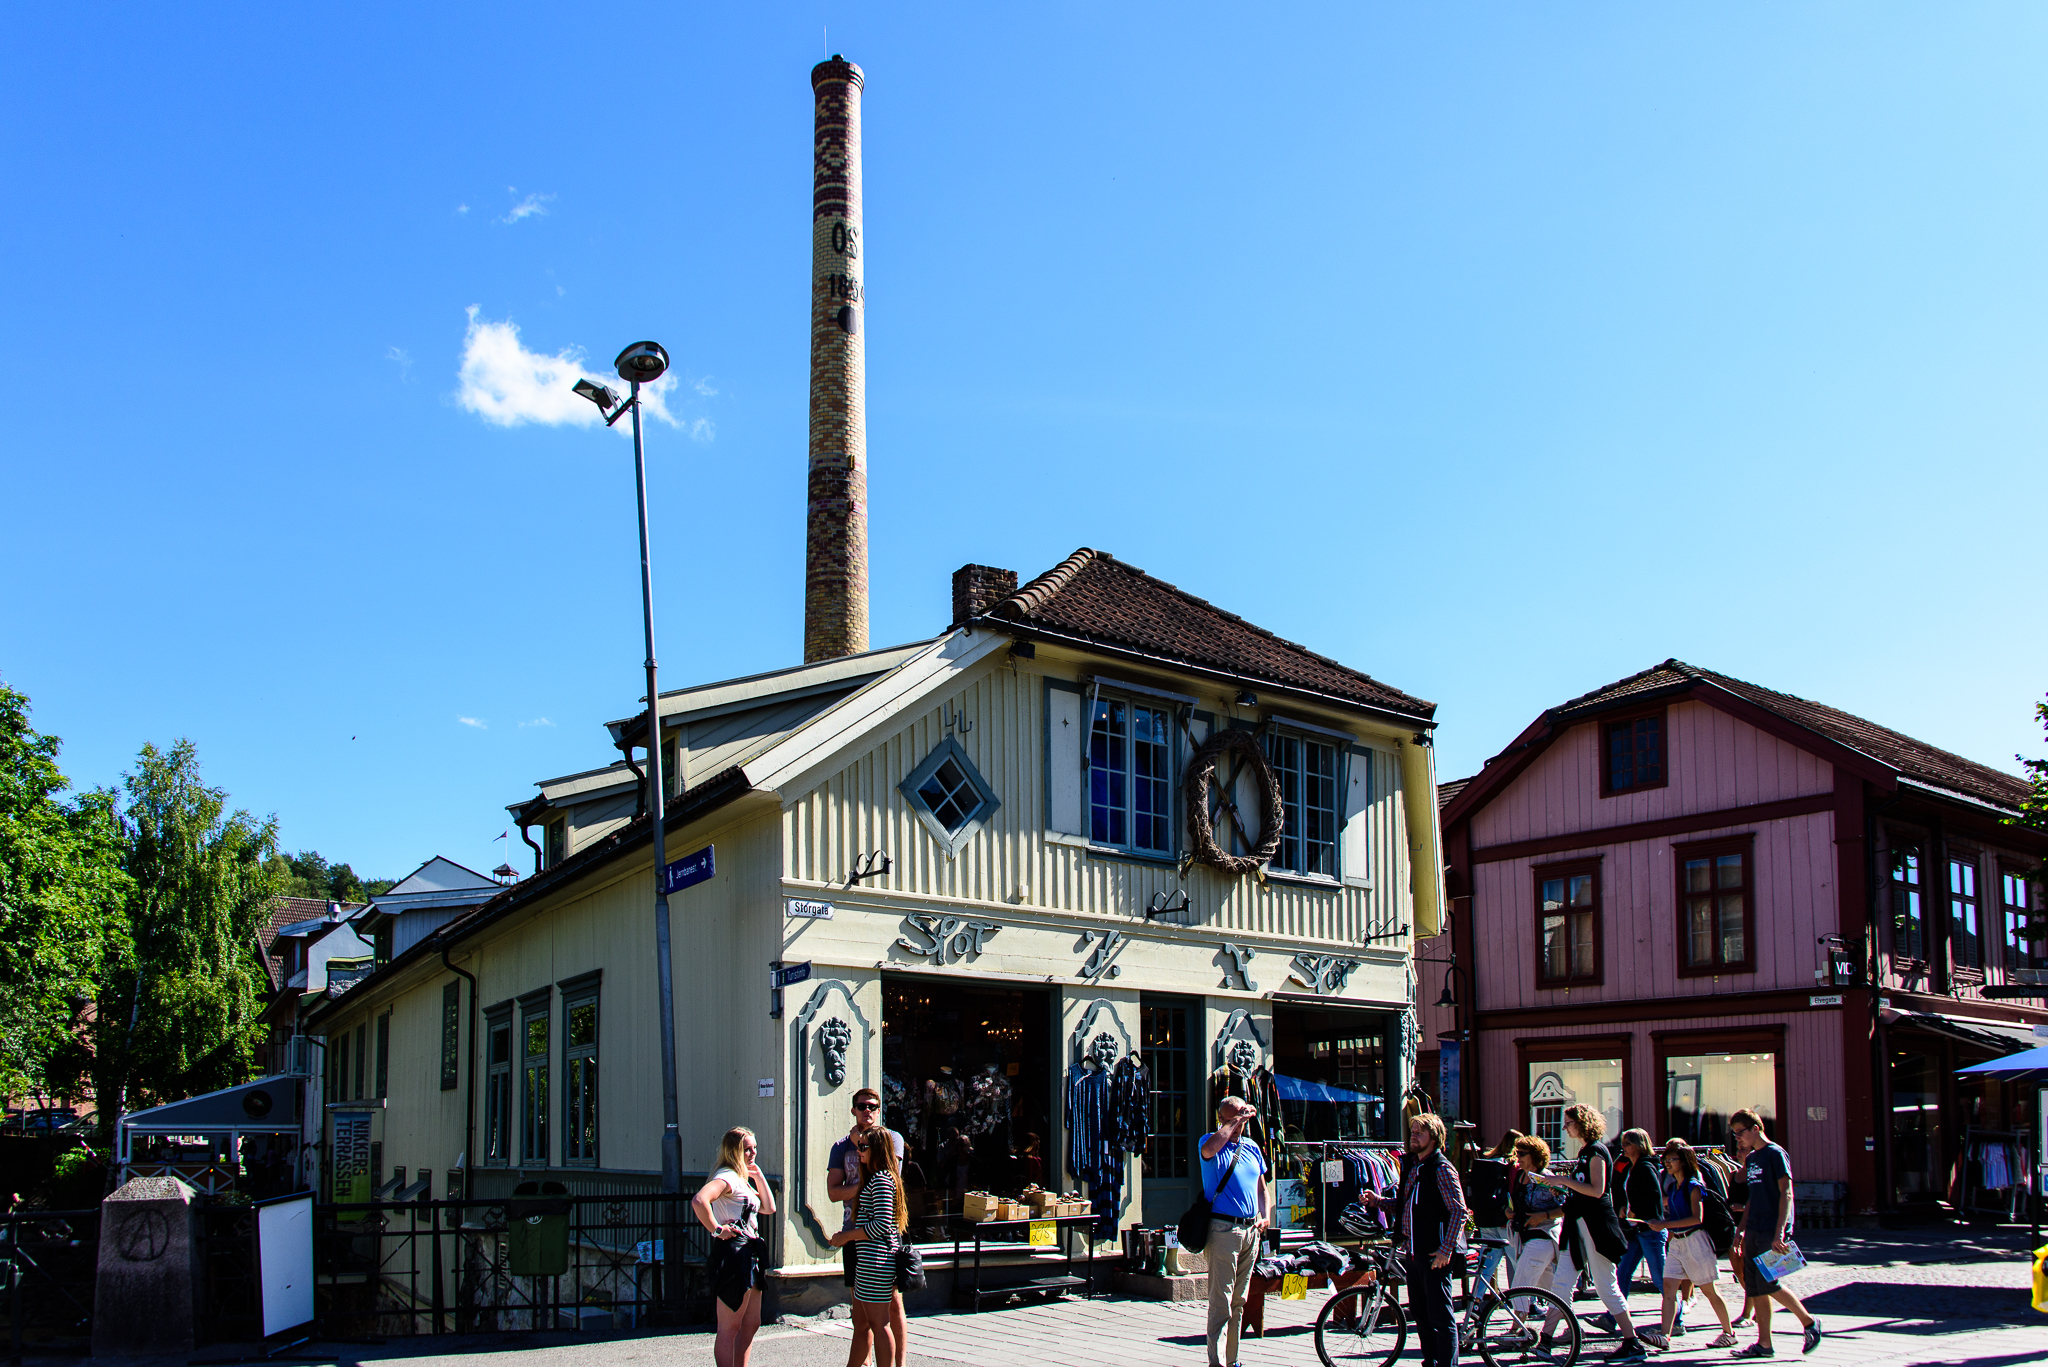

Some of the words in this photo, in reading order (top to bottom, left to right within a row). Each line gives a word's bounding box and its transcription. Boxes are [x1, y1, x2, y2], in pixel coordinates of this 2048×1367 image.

[794, 901, 829, 916] Storgata
[1814, 997, 1837, 1005] Elvegata
[335, 1120, 353, 1197] TERRASSEN
[353, 1120, 370, 1176] NIKKERS
